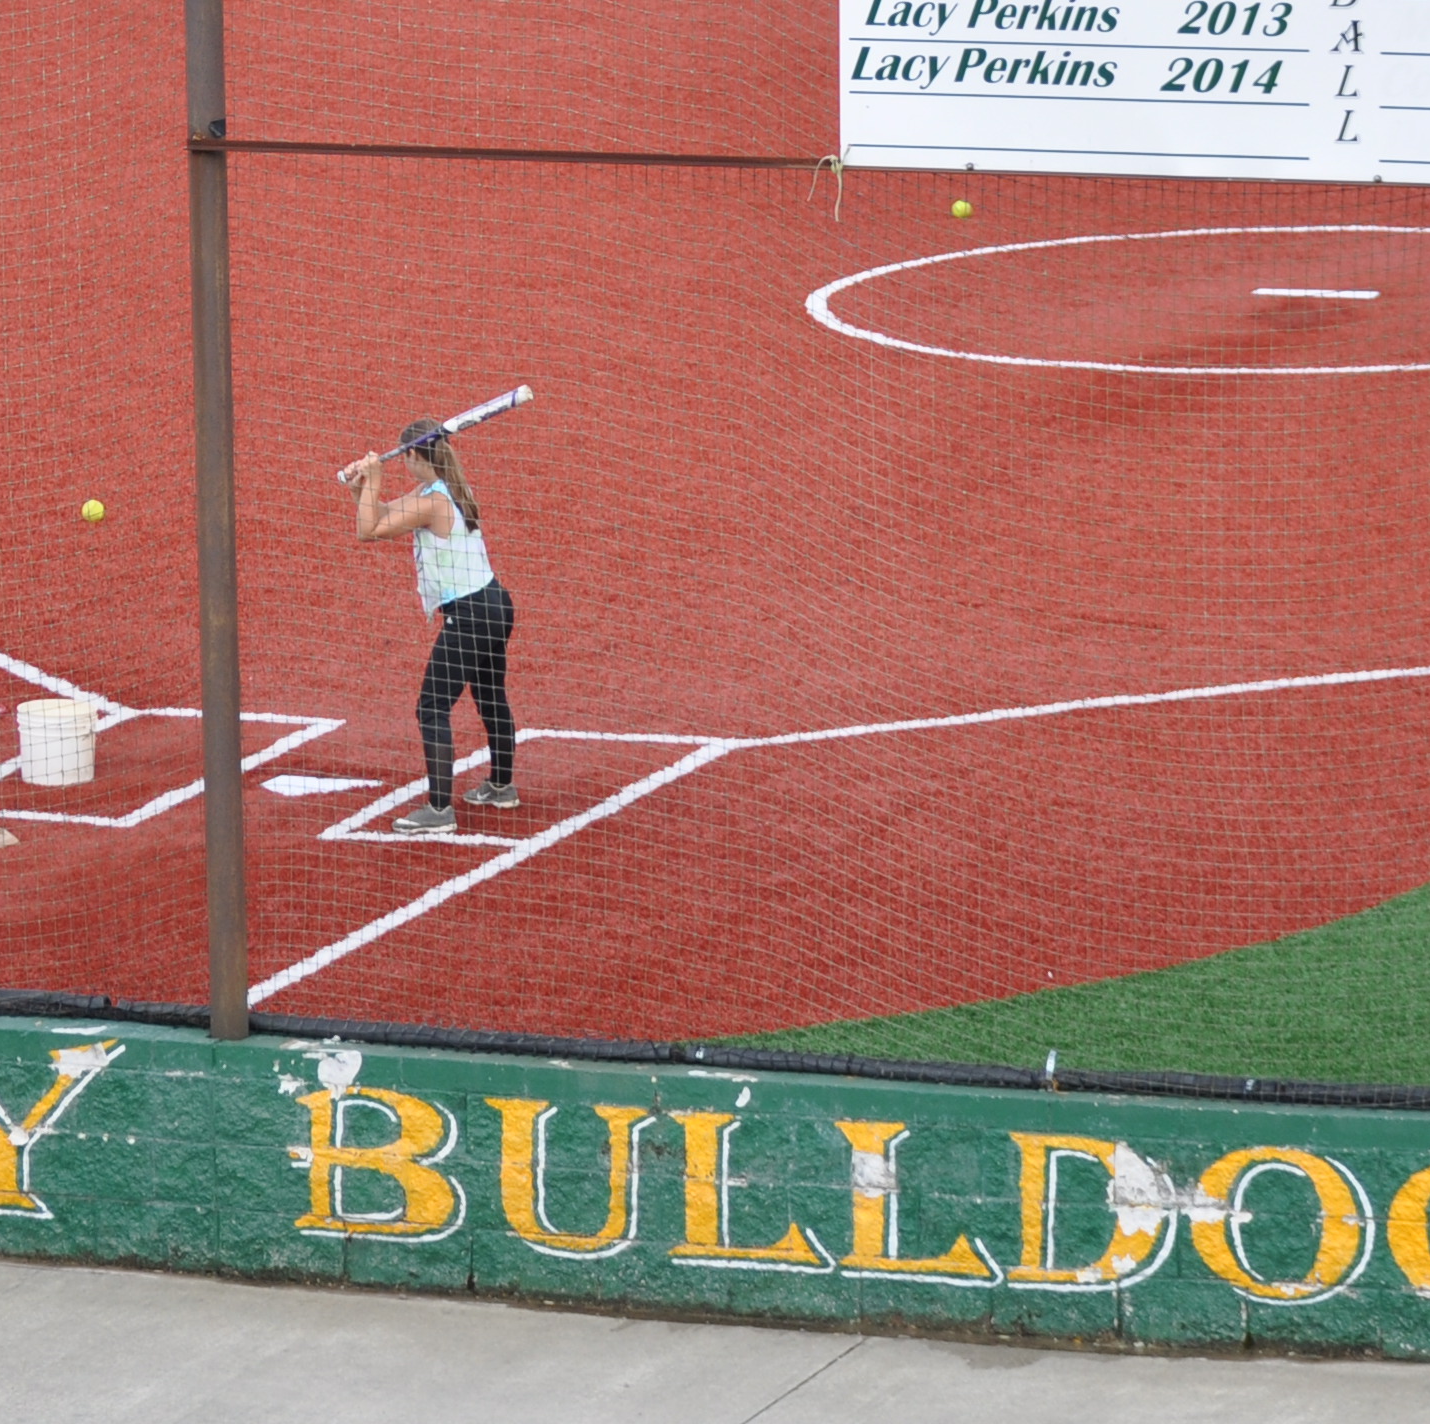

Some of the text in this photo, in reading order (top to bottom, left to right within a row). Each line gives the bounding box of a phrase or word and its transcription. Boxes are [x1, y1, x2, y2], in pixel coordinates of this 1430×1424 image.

[1177, 0, 1293, 37] 2013
[851, 46, 1283, 94] Lacy Perkins 2014
